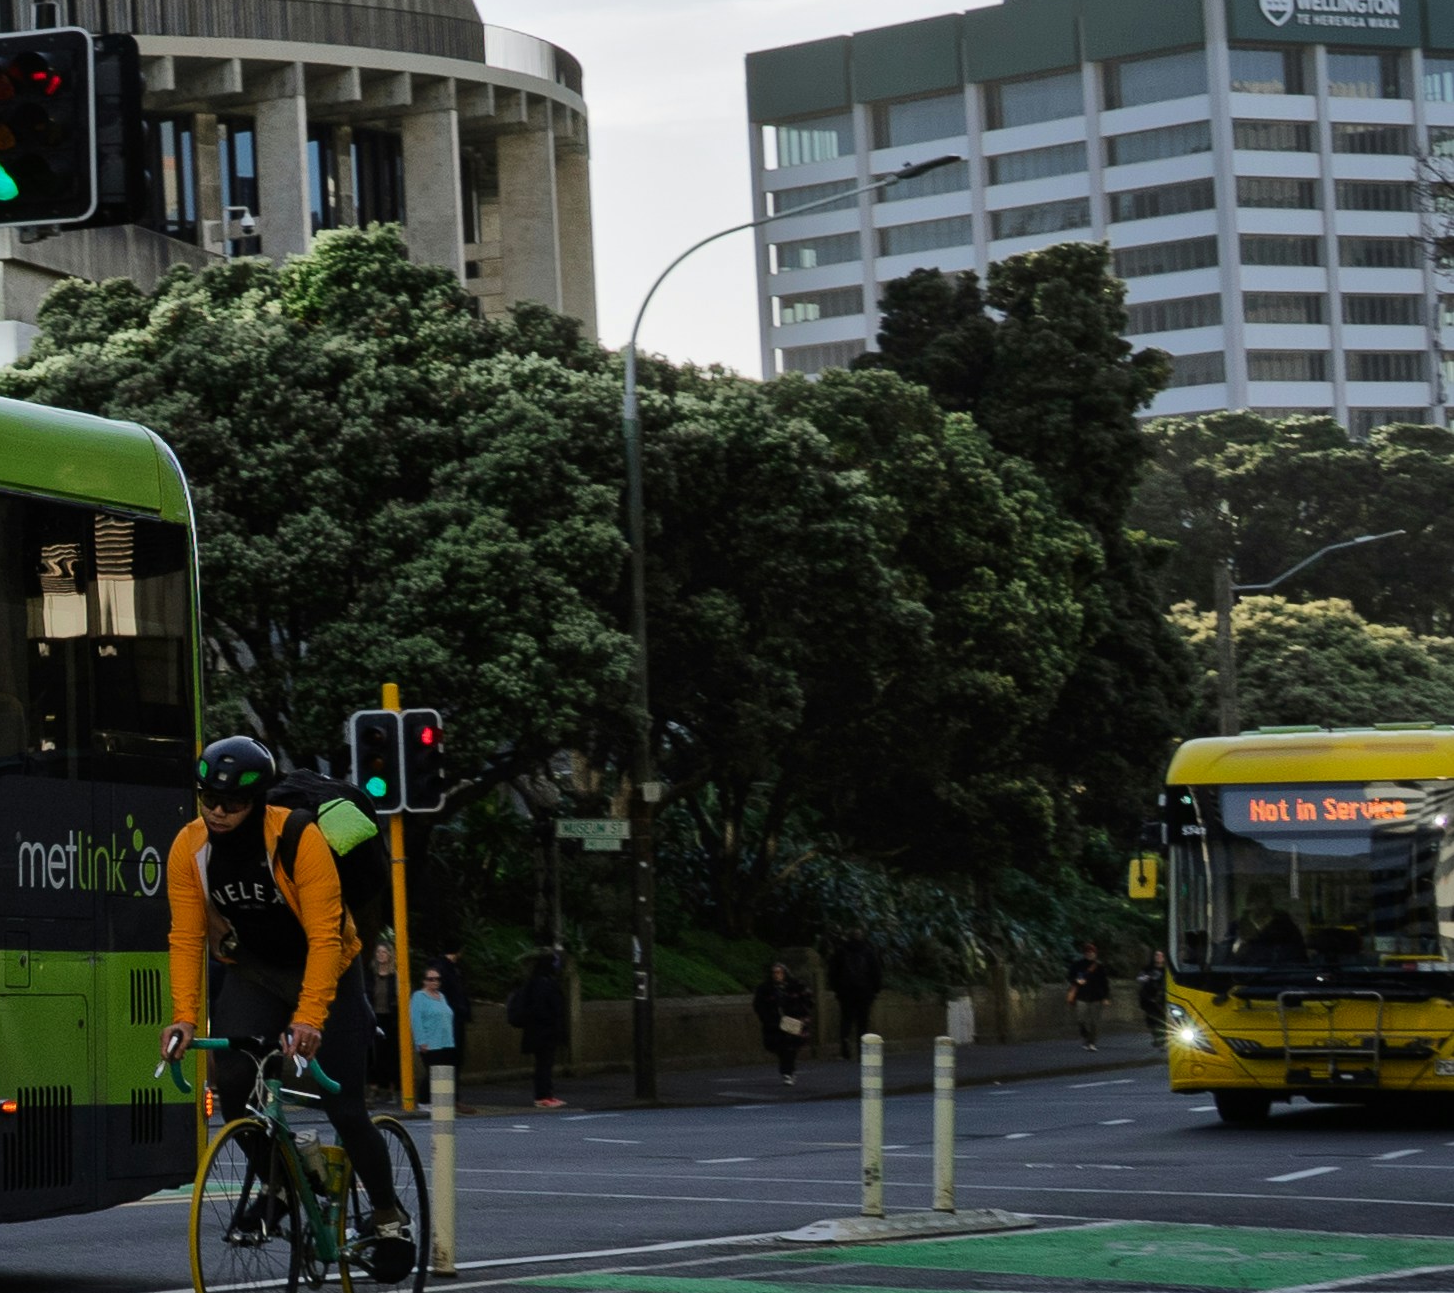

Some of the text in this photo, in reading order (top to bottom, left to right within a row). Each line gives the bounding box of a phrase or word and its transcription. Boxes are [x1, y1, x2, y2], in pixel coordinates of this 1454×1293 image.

[1249, 797, 1408, 822] Not in Service
[18, 829, 127, 893] metlink
